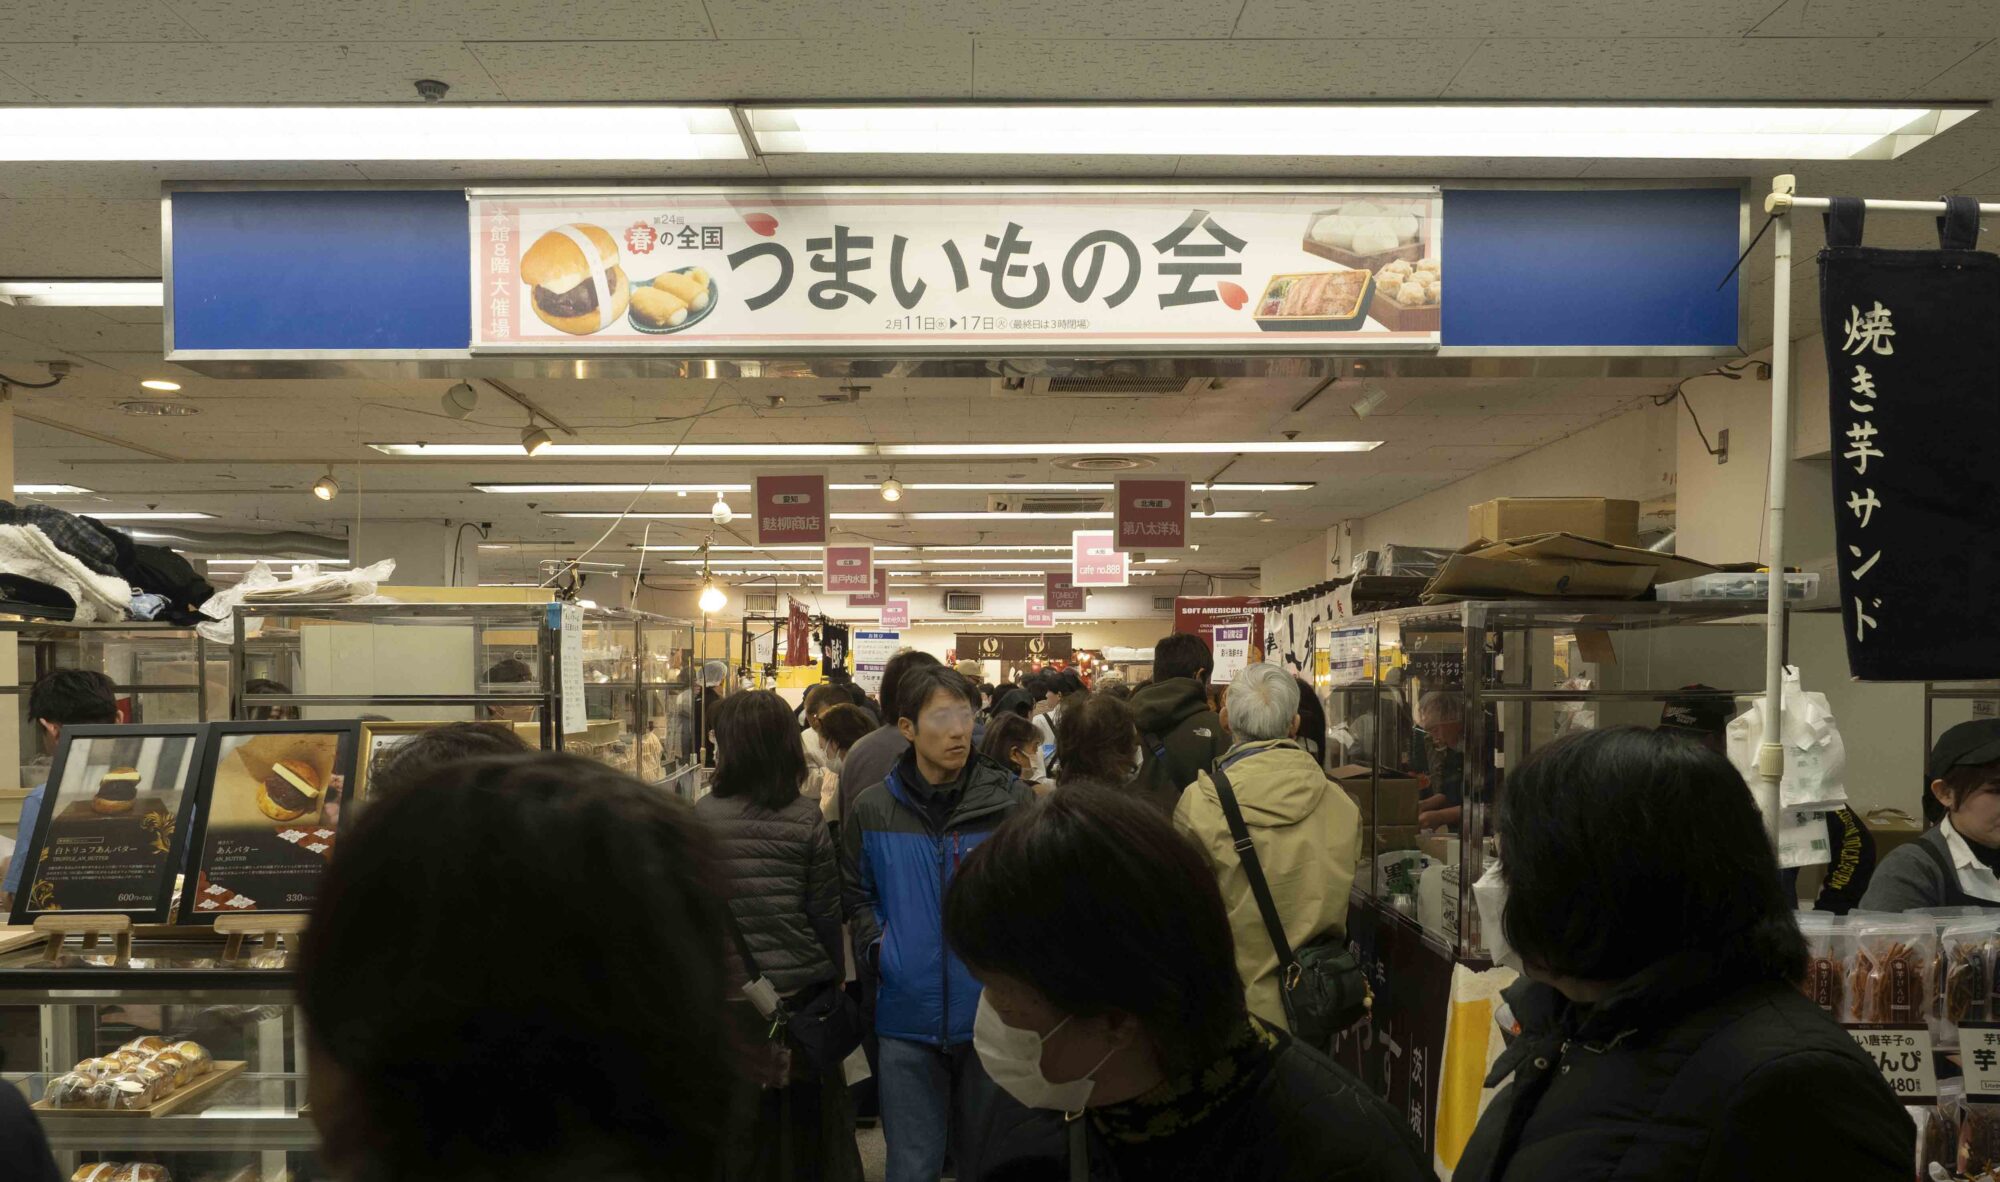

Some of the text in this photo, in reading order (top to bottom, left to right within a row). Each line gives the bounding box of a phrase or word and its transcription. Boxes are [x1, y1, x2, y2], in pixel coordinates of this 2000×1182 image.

[653, 214, 685, 225] 第24回
[631, 225, 723, 250] 春の全国
[728, 208, 1249, 311] うまいもの会
[1842, 300, 1896, 642] 焼き芋サンド
[1123, 521, 1180, 536] 第八太洋丸
[1056, 600, 1073, 608] CAFE
[1182, 607, 1201, 615] SOFT
[1202, 606, 1242, 615] AMERICAN
[1416, 661, 1464, 669] ロイヤルショ
[1424, 669, 1464, 677] ソフトクリ
[55, 845, 138, 855] 白トリュフあんバター
[216, 845, 259, 855] あんバター
[1851, 1034, 1915, 1046] い唐辛子の
[1870, 1050, 1922, 1072] んぴ
